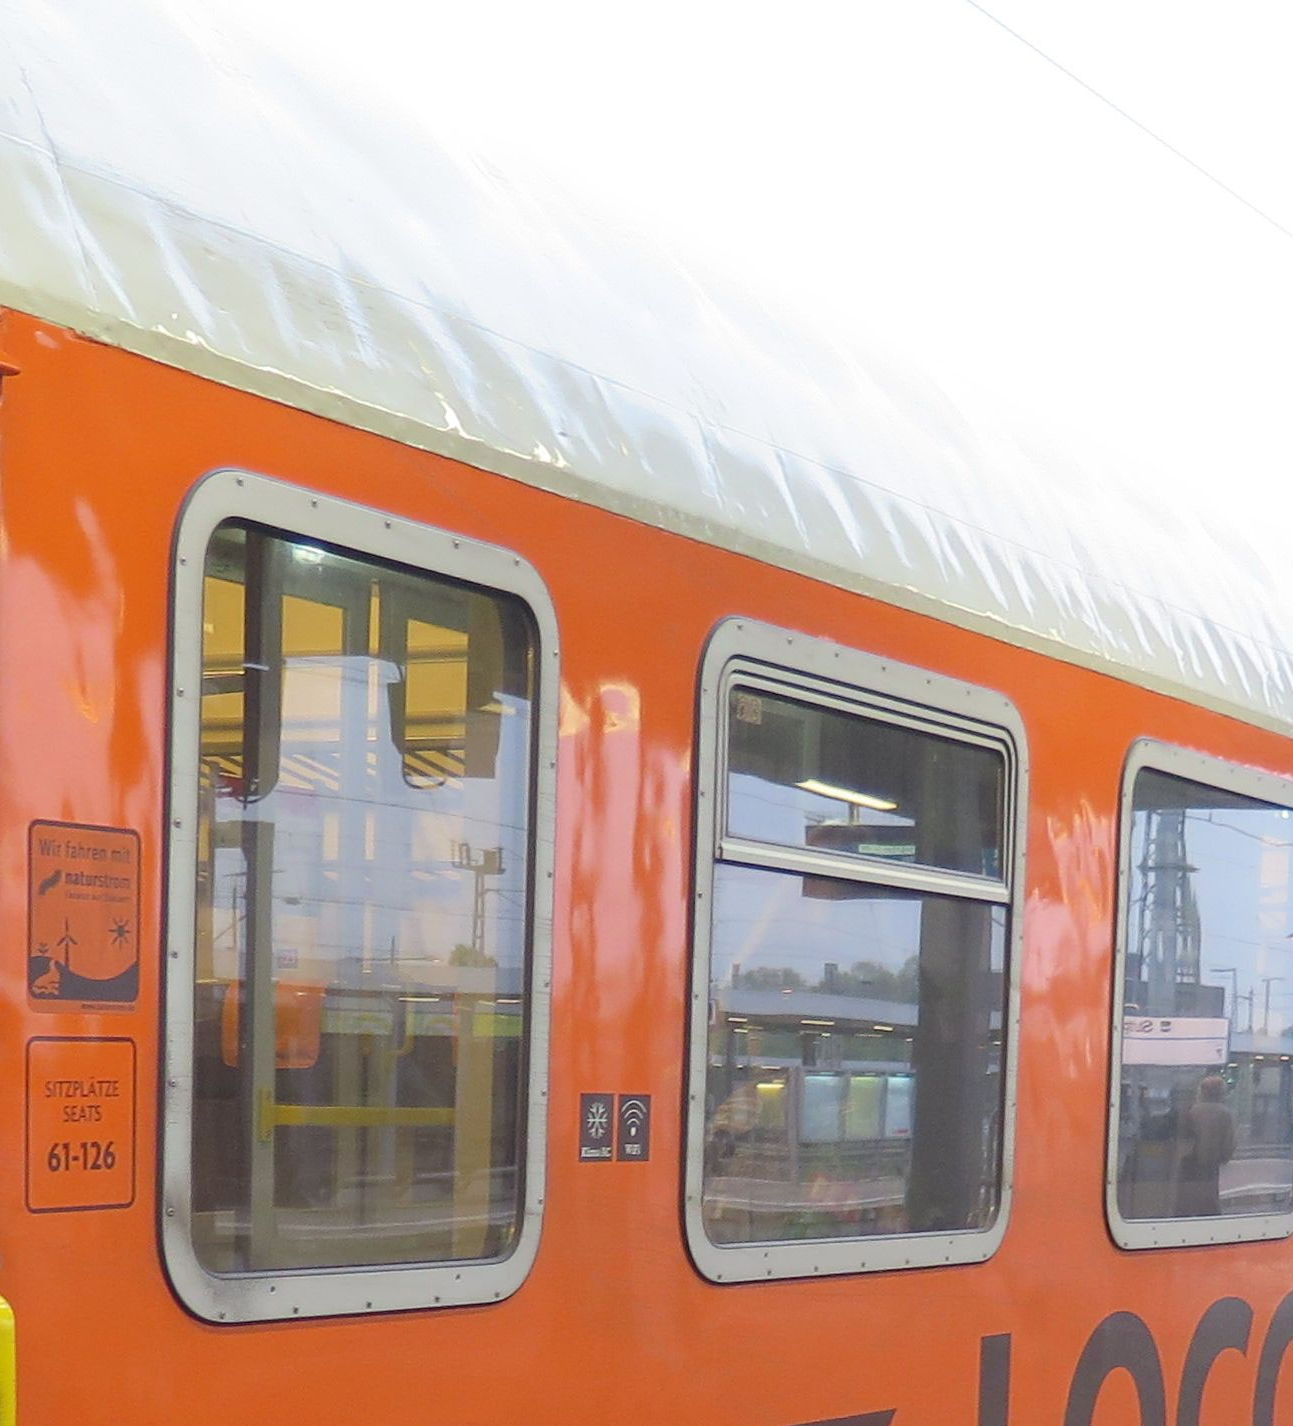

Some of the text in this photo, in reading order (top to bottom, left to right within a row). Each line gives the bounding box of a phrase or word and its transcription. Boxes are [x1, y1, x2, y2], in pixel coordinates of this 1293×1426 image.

[39, 838, 130, 863] Wir fahren mit
[65, 871, 130, 889] naturstrom
[45, 1076, 120, 1098] SITZPLÄTZE
[63, 1105, 102, 1122] SEATS
[48, 1141, 116, 1172] 61-126
